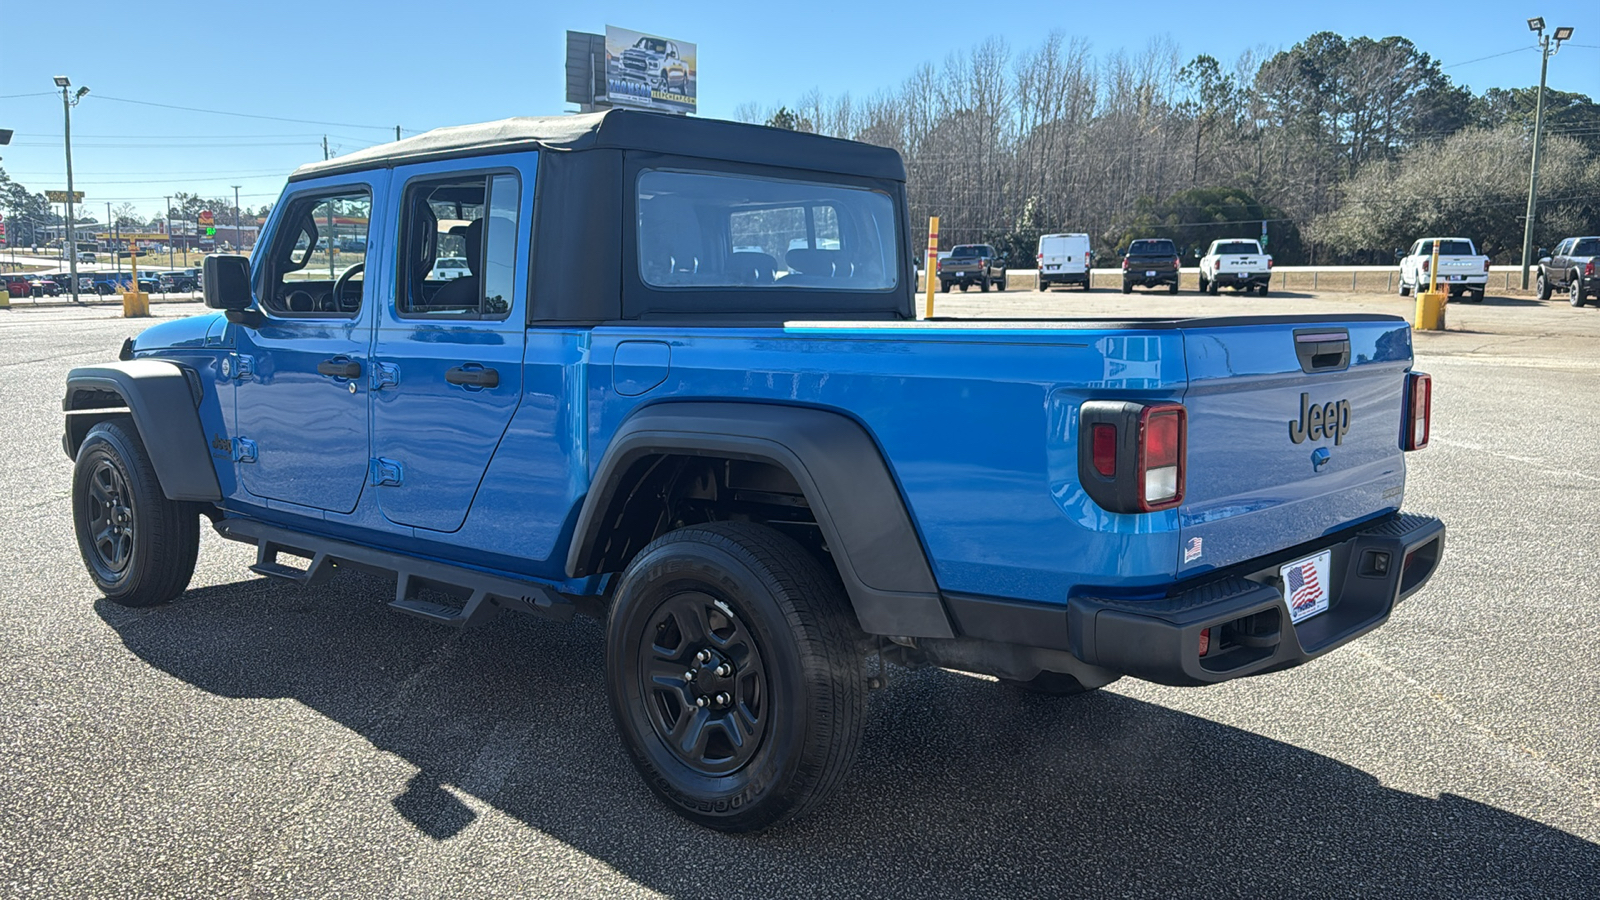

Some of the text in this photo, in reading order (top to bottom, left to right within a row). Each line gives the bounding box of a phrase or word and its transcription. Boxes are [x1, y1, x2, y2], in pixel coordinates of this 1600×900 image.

[609, 78, 651, 98] THOMSON
[1289, 392, 1351, 446] Jeep
[212, 433, 232, 454] Jeep
